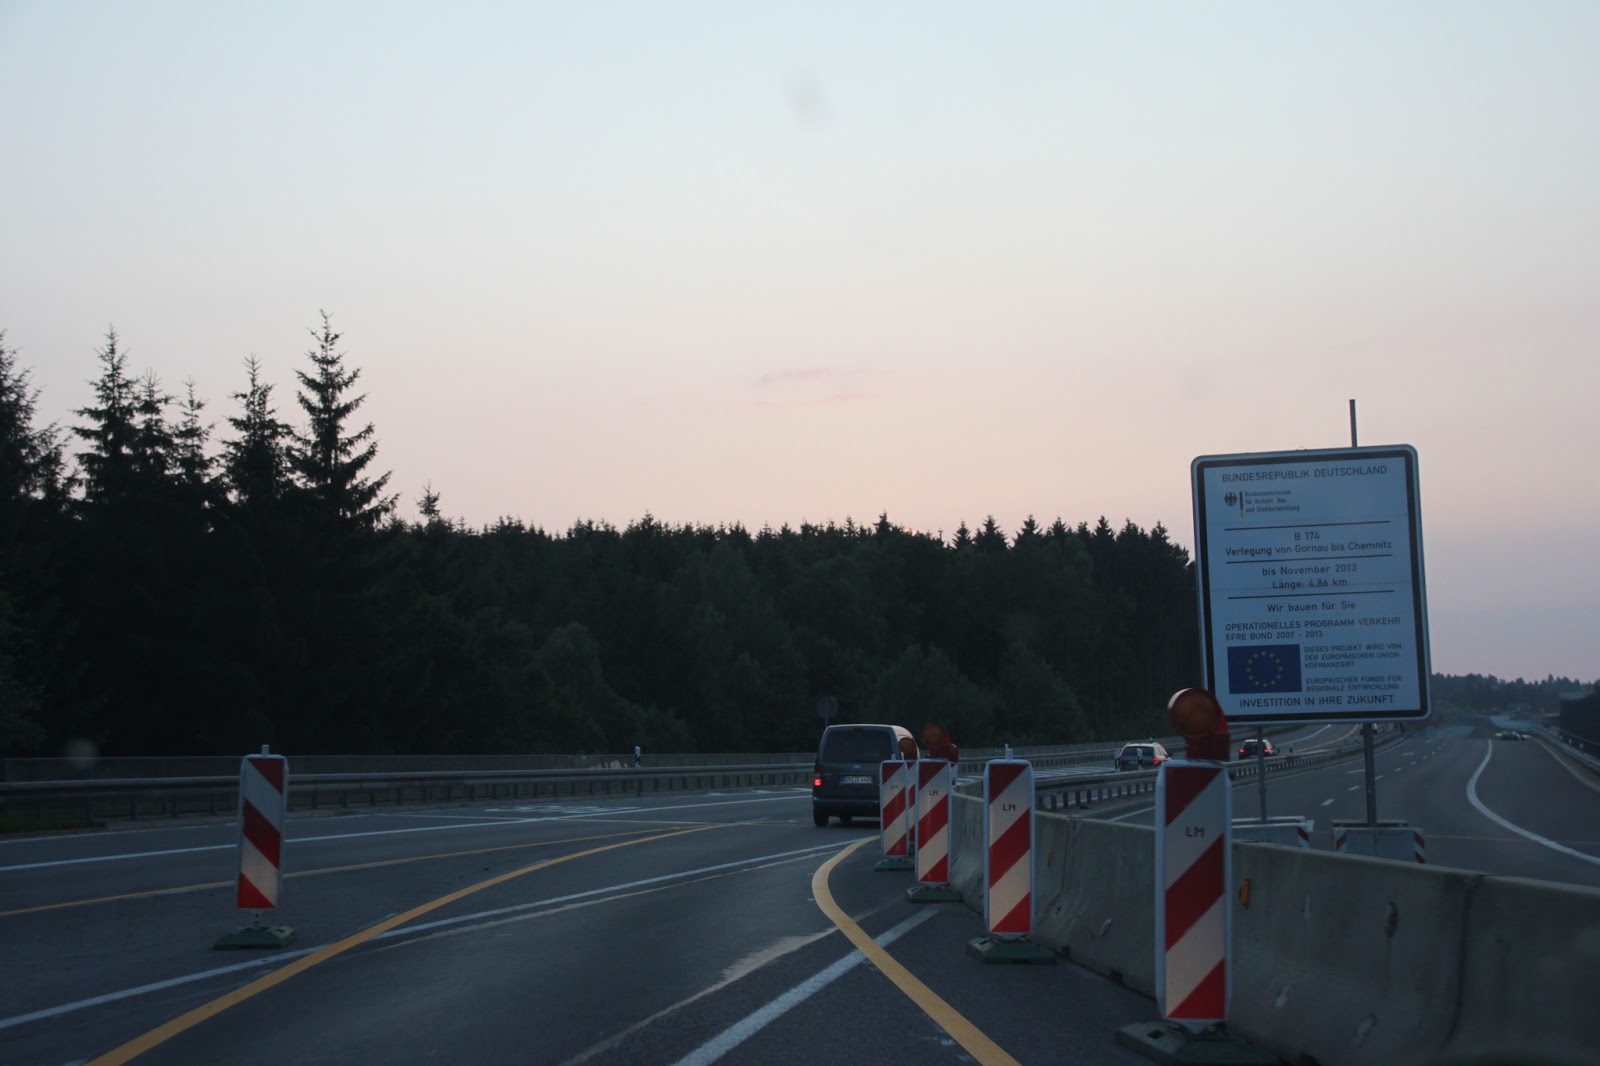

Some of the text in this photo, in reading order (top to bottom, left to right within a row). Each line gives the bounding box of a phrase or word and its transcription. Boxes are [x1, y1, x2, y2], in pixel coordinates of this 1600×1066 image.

[1222, 466, 1387, 482] BUNDESREPUBLIK DEUTSCHLAND
[1306, 532, 1320, 540] 174
[1226, 546, 1272, 557] Verlegung
[1295, 544, 1328, 552] Gornau
[1331, 543, 1345, 551] bis
[1348, 541, 1392, 550] Chemnitz
[1262, 564, 1357, 575] bis November 2013
[1272, 580, 1304, 590] Länge:
[1332, 578, 1348, 586] km
[1267, 601, 1356, 612] Wir bauen für Sie
[1226, 617, 1400, 631] OPERATIONELLES PROGRAMM VERKEHR
[1276, 631, 1294, 639] 2007
[1305, 630, 1323, 638] 2013
[1322, 652, 1374, 660] EUROPÄISCHEN
[1306, 676, 1358, 684] EUROPÄISCHER
[1240, 694, 1394, 708] INVESTITION IN IHRE ZUKUNFT
[1186, 827, 1205, 837] LM
